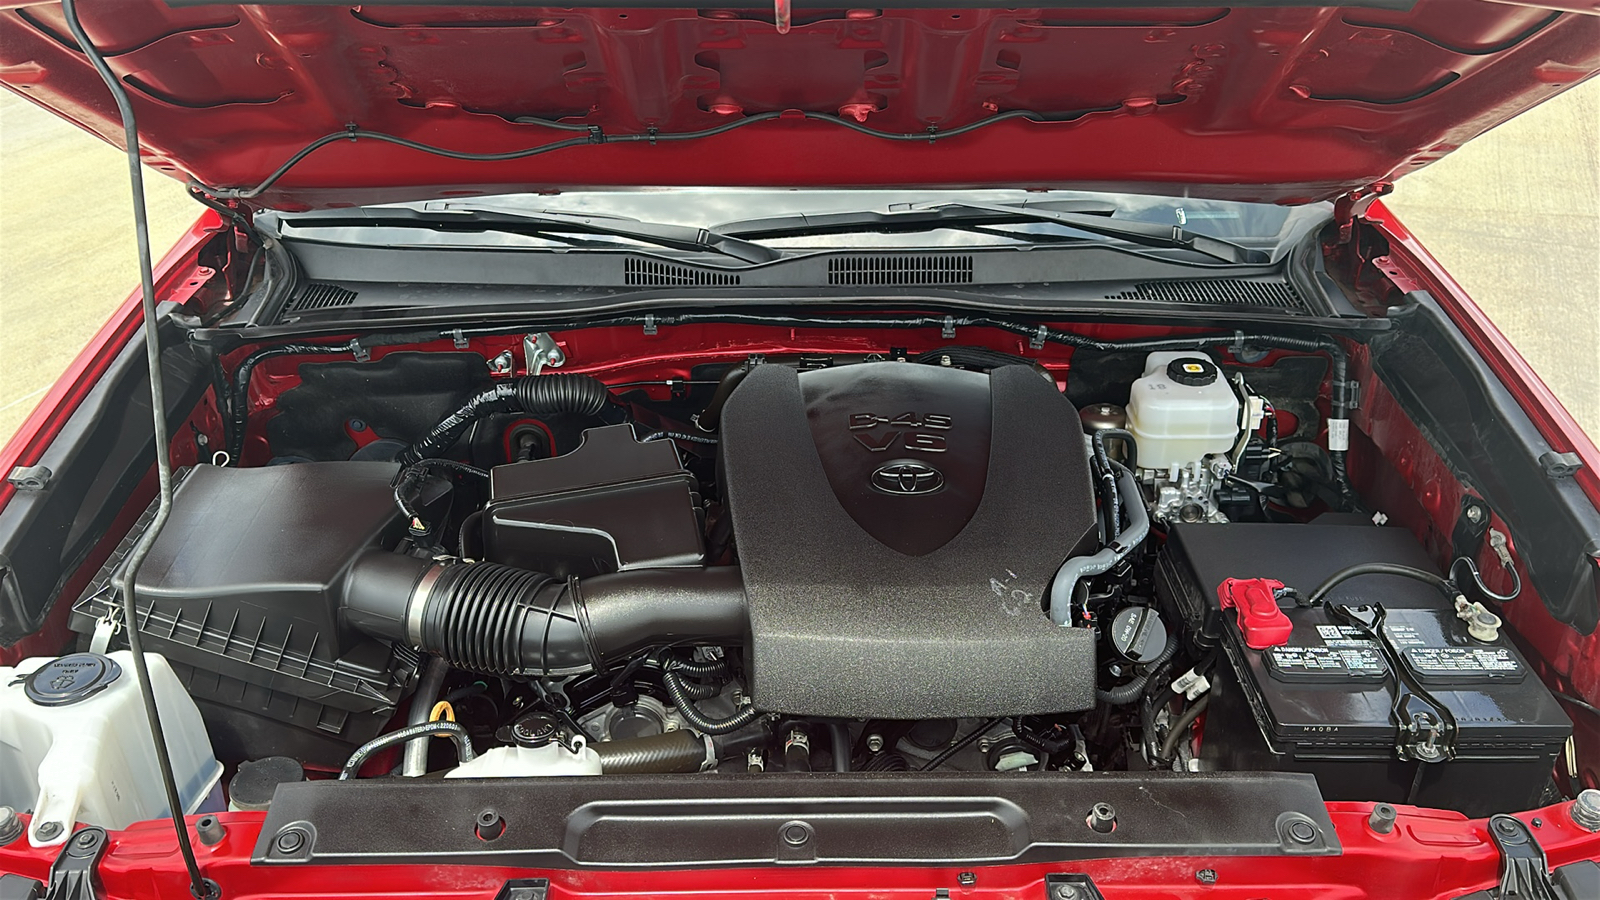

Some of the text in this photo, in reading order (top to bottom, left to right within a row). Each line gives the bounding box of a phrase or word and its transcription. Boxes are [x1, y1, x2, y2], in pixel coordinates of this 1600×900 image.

[849, 411, 953, 430] D-4S
[853, 431, 947, 452] V6
[1128, 612, 1137, 625] SAE
